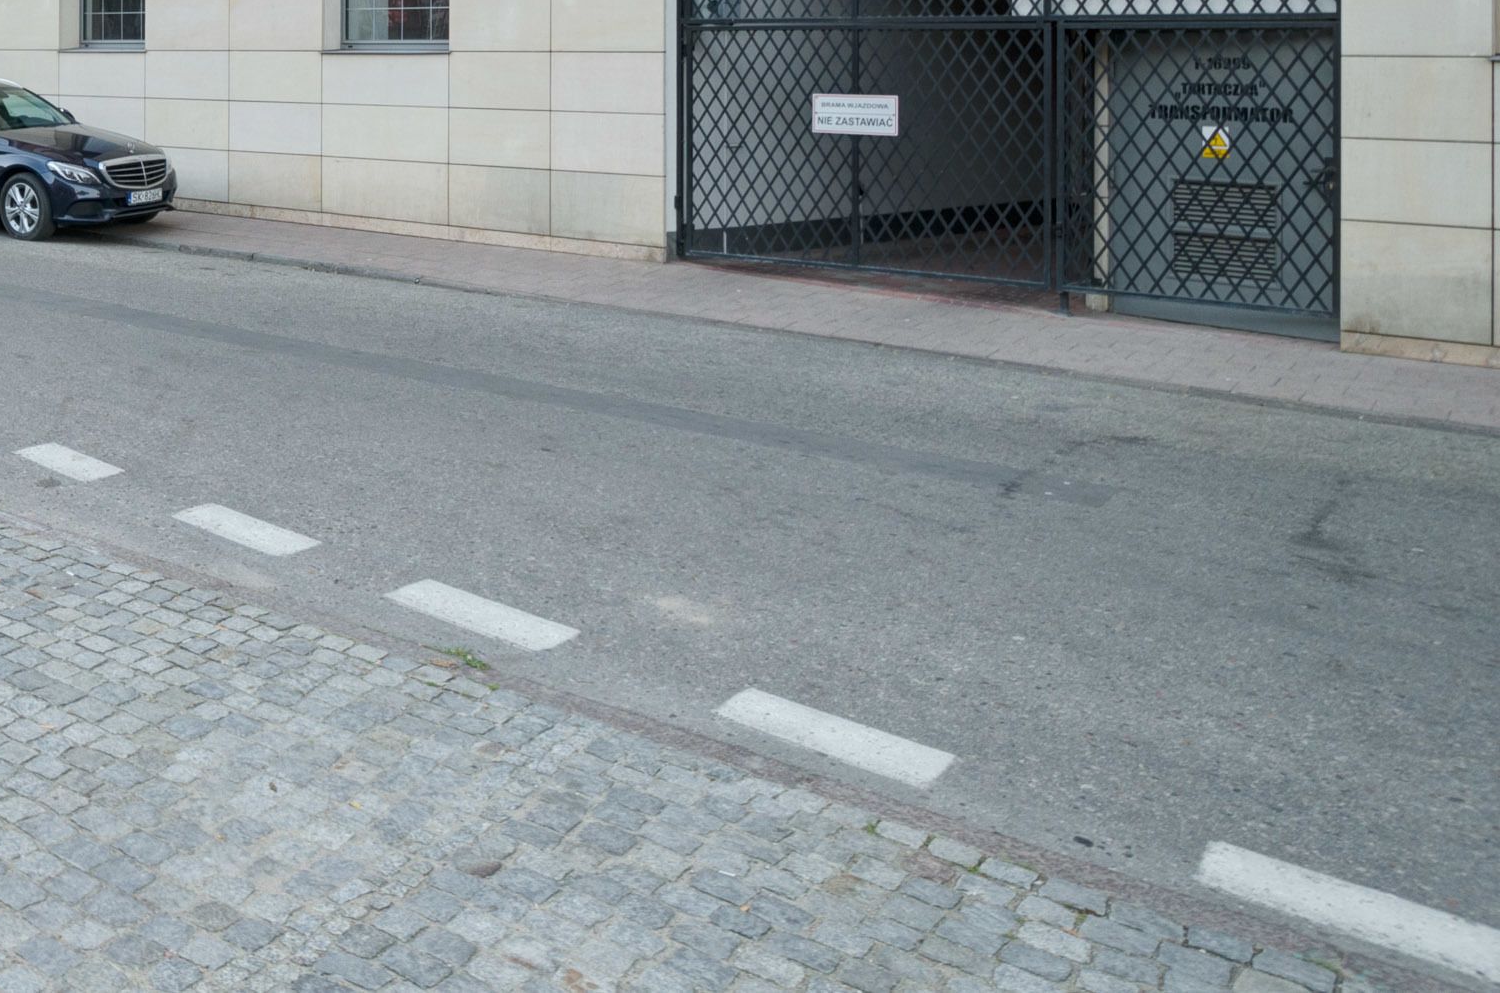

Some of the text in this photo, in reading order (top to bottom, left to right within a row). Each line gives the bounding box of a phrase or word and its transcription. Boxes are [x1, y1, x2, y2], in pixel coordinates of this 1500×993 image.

[1149, 104, 1294, 123] TRANSFORMATOR
[817, 116, 893, 127] NIE ZASTAWIAĆ
